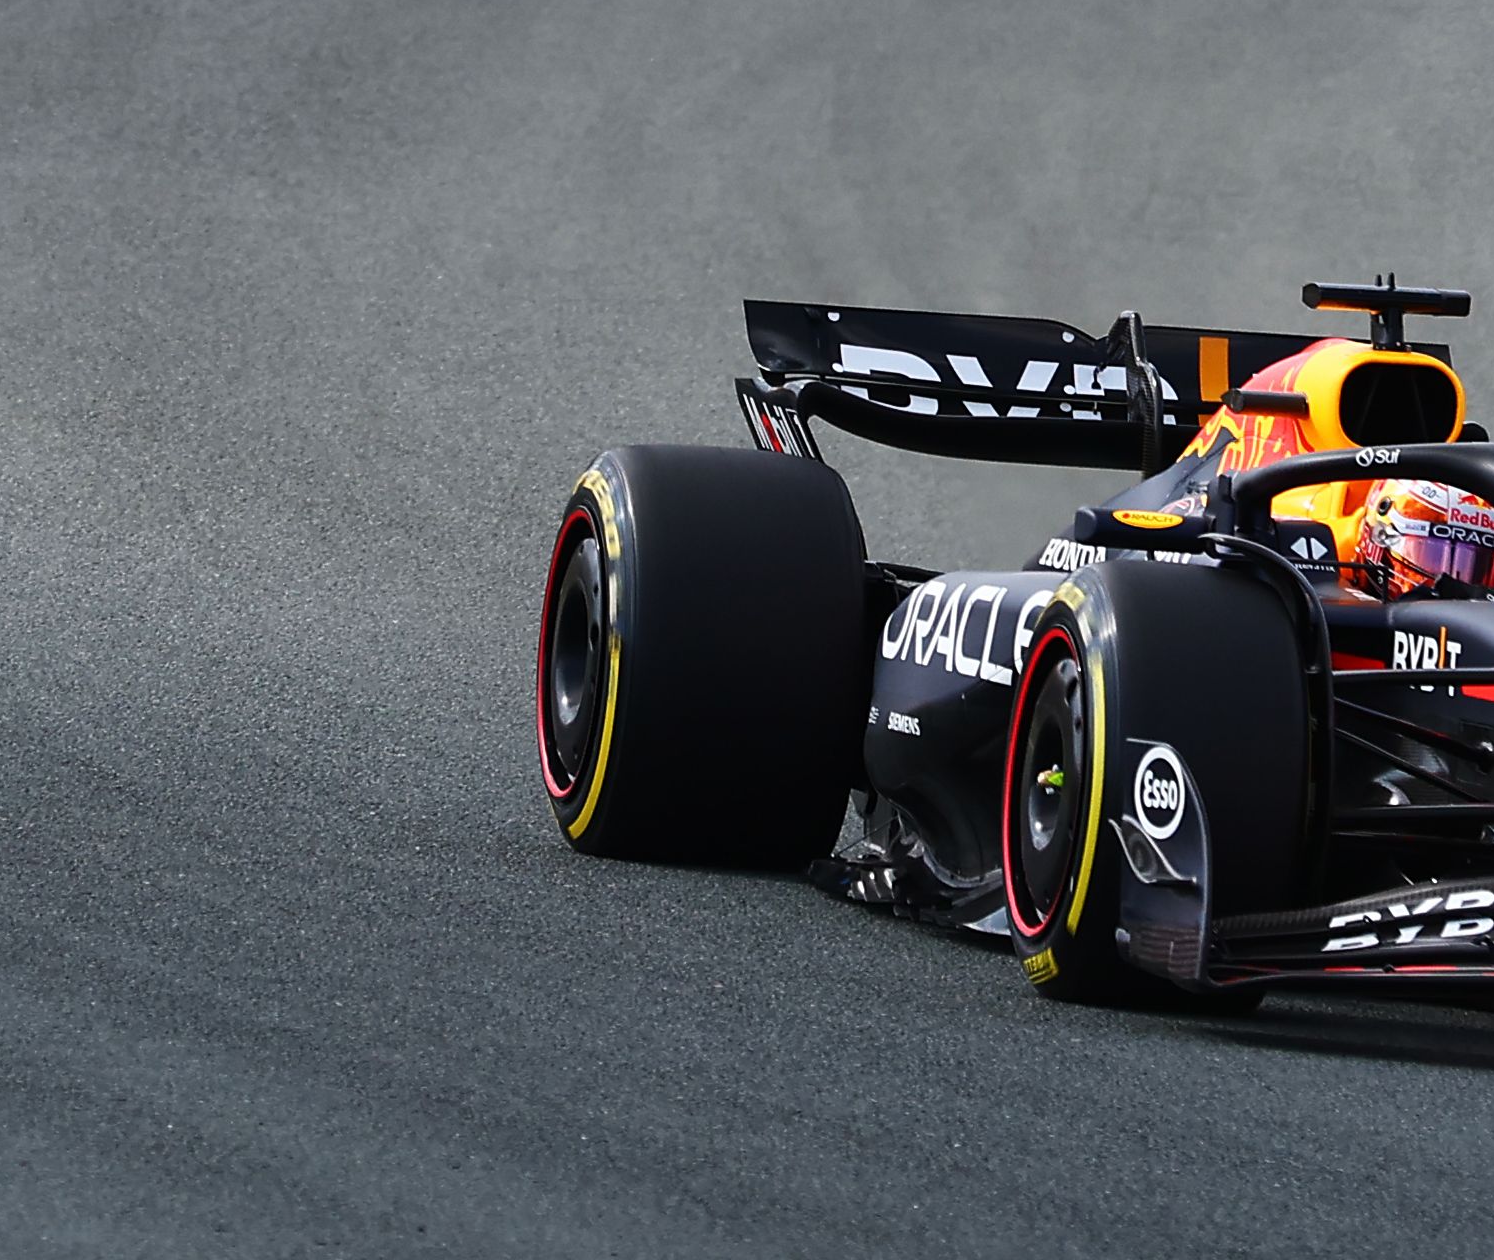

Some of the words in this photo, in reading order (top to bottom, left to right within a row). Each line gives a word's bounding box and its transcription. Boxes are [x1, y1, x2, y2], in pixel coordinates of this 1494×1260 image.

[1131, 513, 1174, 524] RAUCH
[1450, 507, 1479, 526] Red
[1038, 537, 1107, 572] HONDA
[882, 580, 1056, 686] ORACLE
[888, 711, 921, 736] SIEMENS
[1143, 769, 1178, 811] Esso
